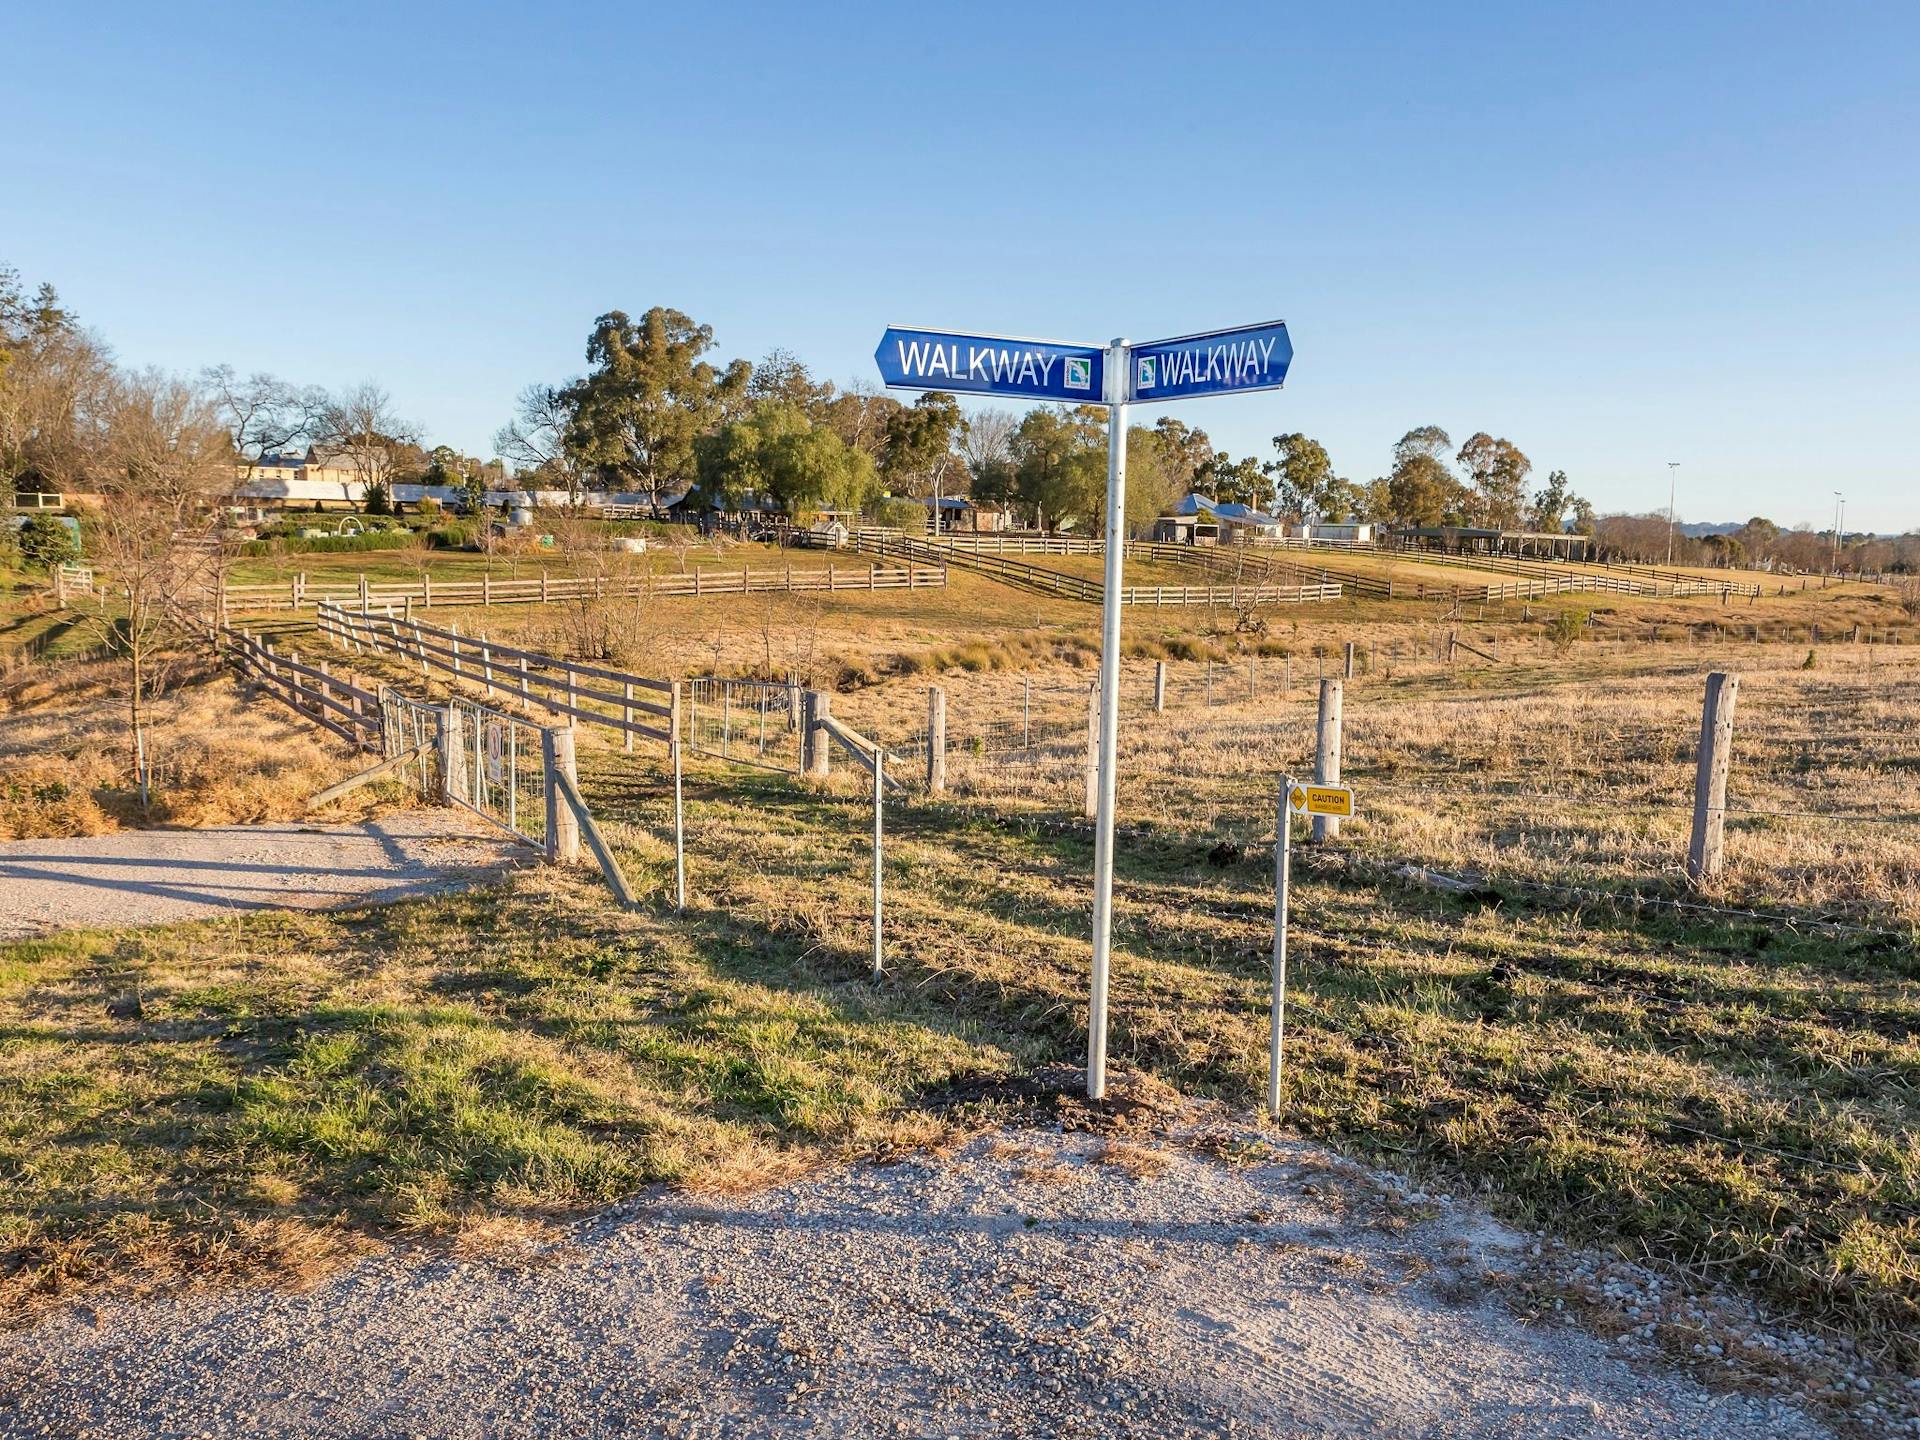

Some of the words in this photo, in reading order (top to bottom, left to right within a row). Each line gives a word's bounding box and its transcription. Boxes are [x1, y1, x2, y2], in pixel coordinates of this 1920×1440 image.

[898, 340, 1057, 386] WALKWAY
[1161, 337, 1276, 386] WALKWAY
[1312, 794, 1345, 804] CAUTION
